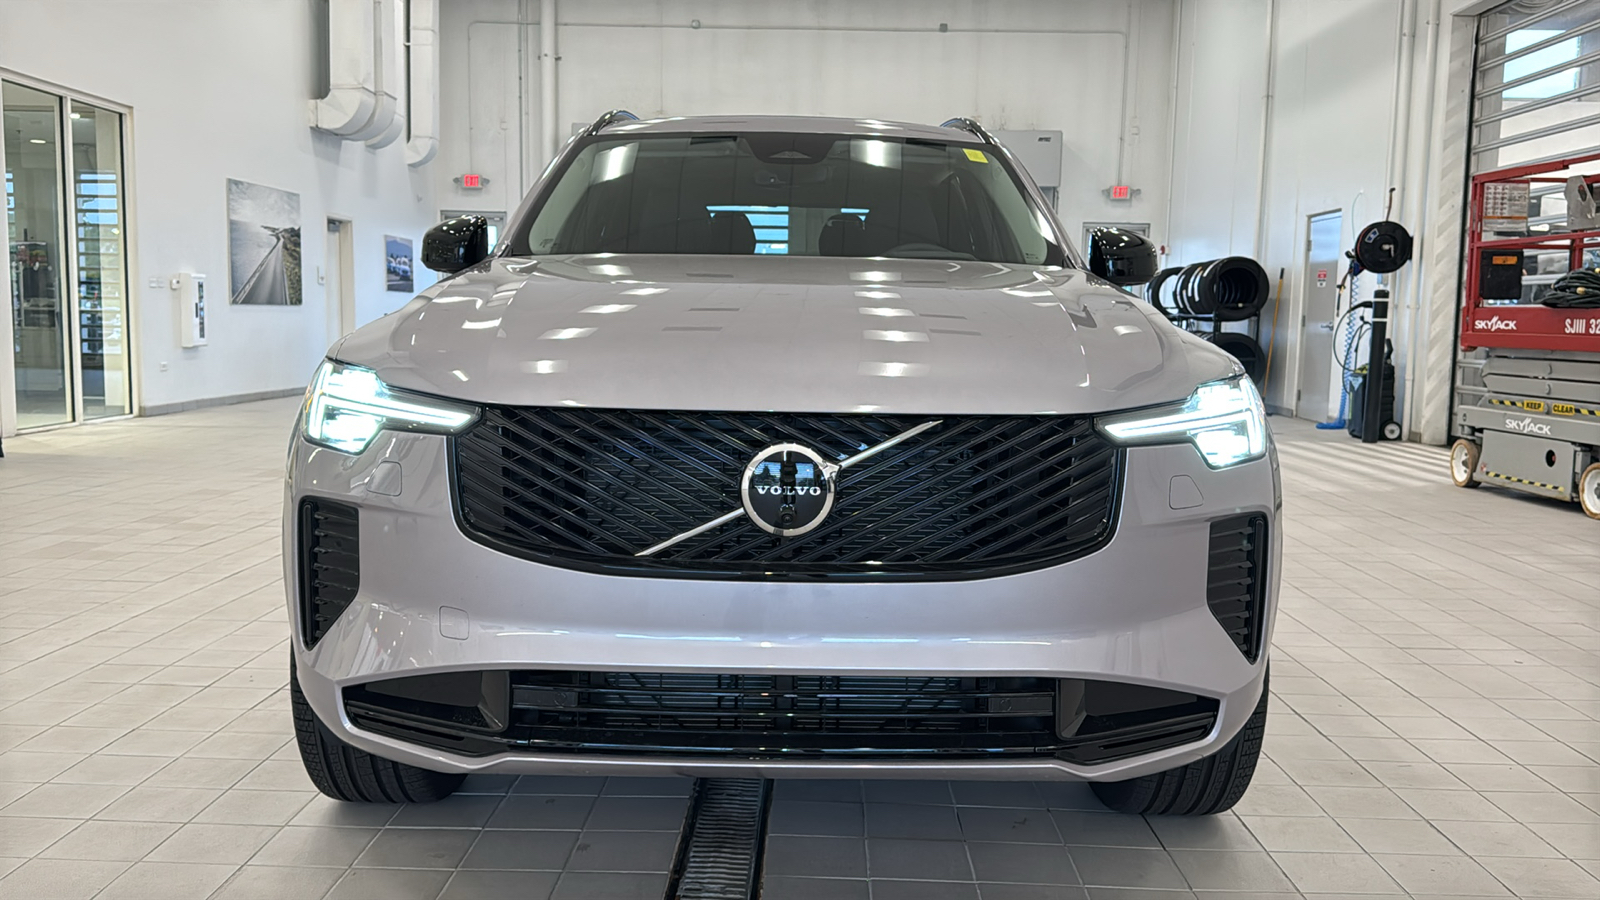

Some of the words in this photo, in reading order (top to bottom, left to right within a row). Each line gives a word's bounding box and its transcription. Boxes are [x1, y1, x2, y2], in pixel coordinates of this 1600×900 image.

[1474, 316, 1517, 332] SKYJACK
[1525, 401, 1542, 411] KEEP
[1553, 404, 1574, 414] CLEAR
[1505, 417, 1551, 435] SKYJACK
[755, 485, 821, 495] VOLVO
